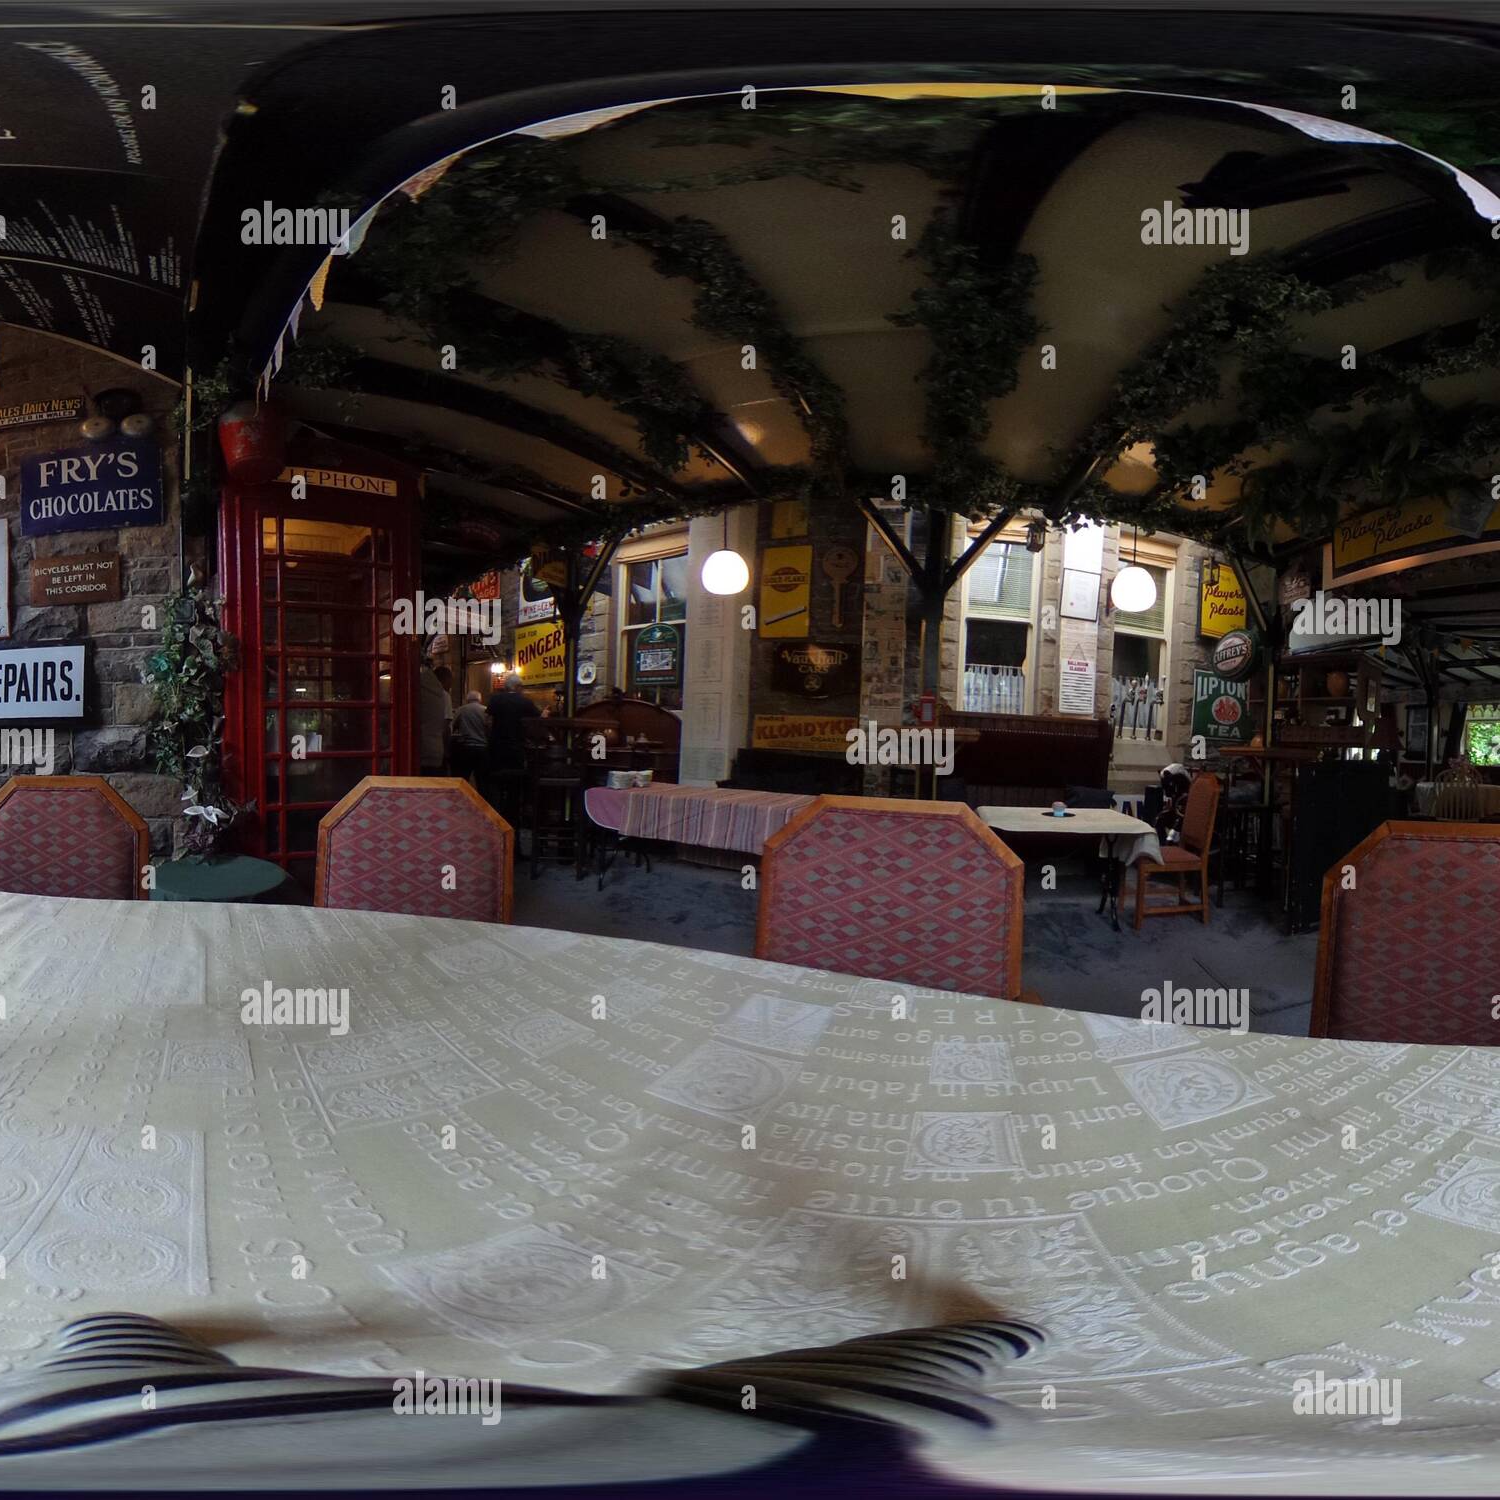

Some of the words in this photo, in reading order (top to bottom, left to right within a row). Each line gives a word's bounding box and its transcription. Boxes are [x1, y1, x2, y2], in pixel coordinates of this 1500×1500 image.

[22, 402, 50, 415] DAILY
[51, 399, 81, 411] NEWS
[38, 451, 139, 488] FRY'S
[29, 488, 154, 520] CHOCOLATES
[1374, 511, 1433, 546] Please
[34, 564, 70, 577] BICYCLES
[72, 562, 94, 573] MUST
[96, 560, 114, 570] NOT
[52, 576, 62, 585] BE
[64, 574, 82, 583] LEFT
[86, 573, 96, 581] IN
[45, 587, 63, 597] THIS
[65, 583, 108, 594] CORRIDOR
[1209, 602, 1245, 620] Please
[1207, 723, 1241, 738] TEA
